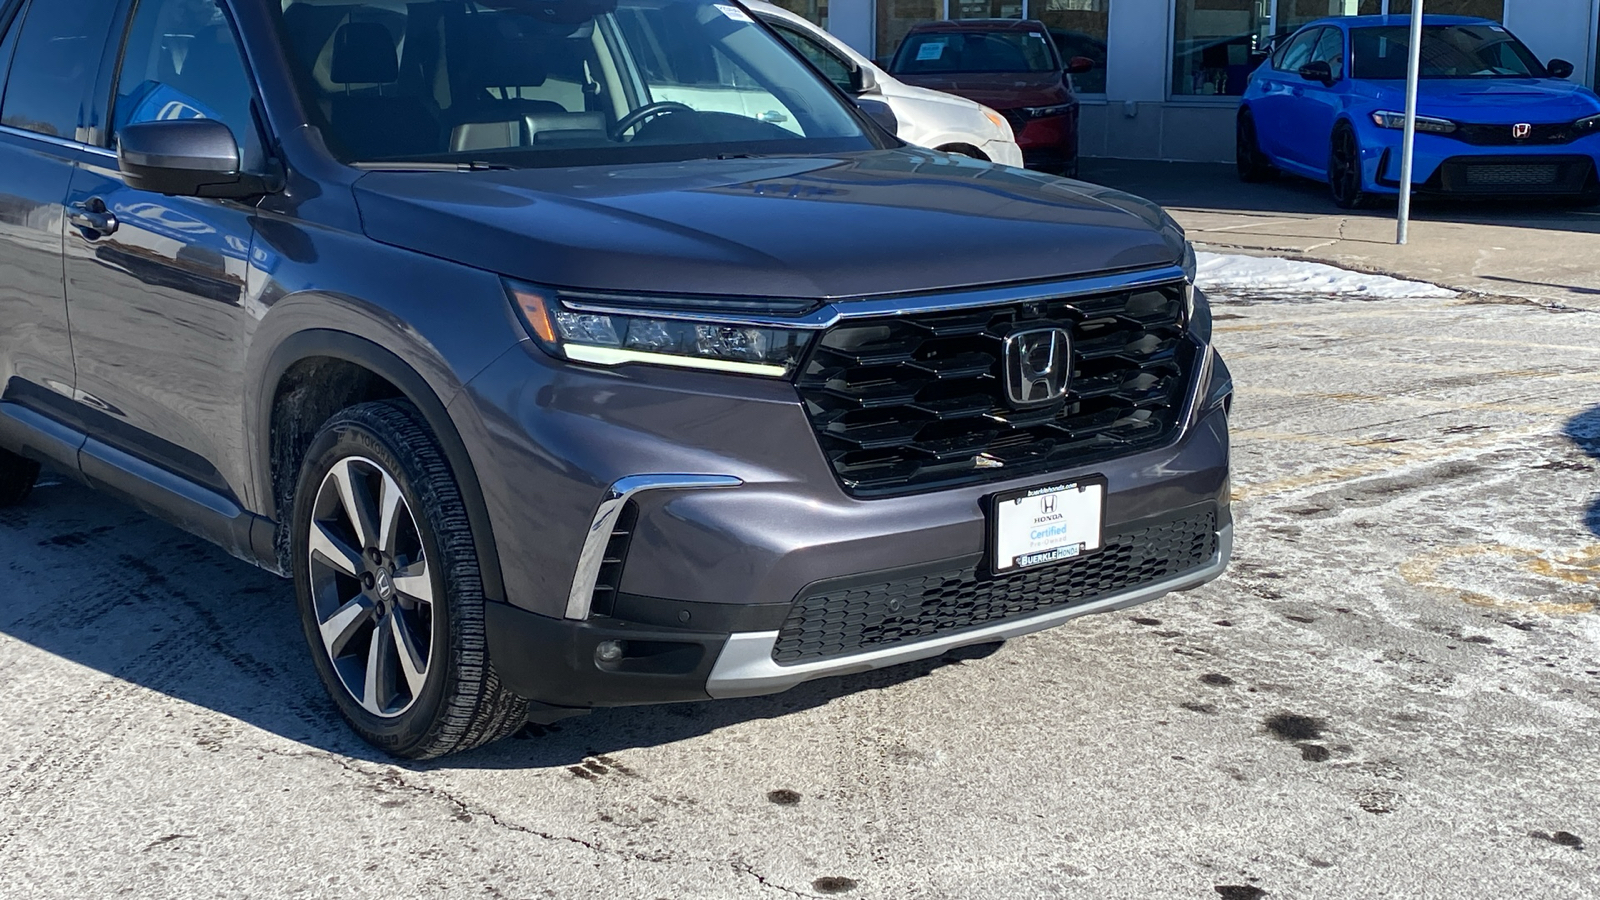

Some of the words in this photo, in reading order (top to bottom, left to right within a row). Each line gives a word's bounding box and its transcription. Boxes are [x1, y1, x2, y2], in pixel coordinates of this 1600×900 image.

[360, 432, 402, 482] YOKOHAMA
[1027, 483, 1077, 497] buerklehonda.com
[1034, 513, 1063, 523] HONDA
[1030, 524, 1067, 540] Certified
[1029, 536, 1067, 547] Pre-Owned
